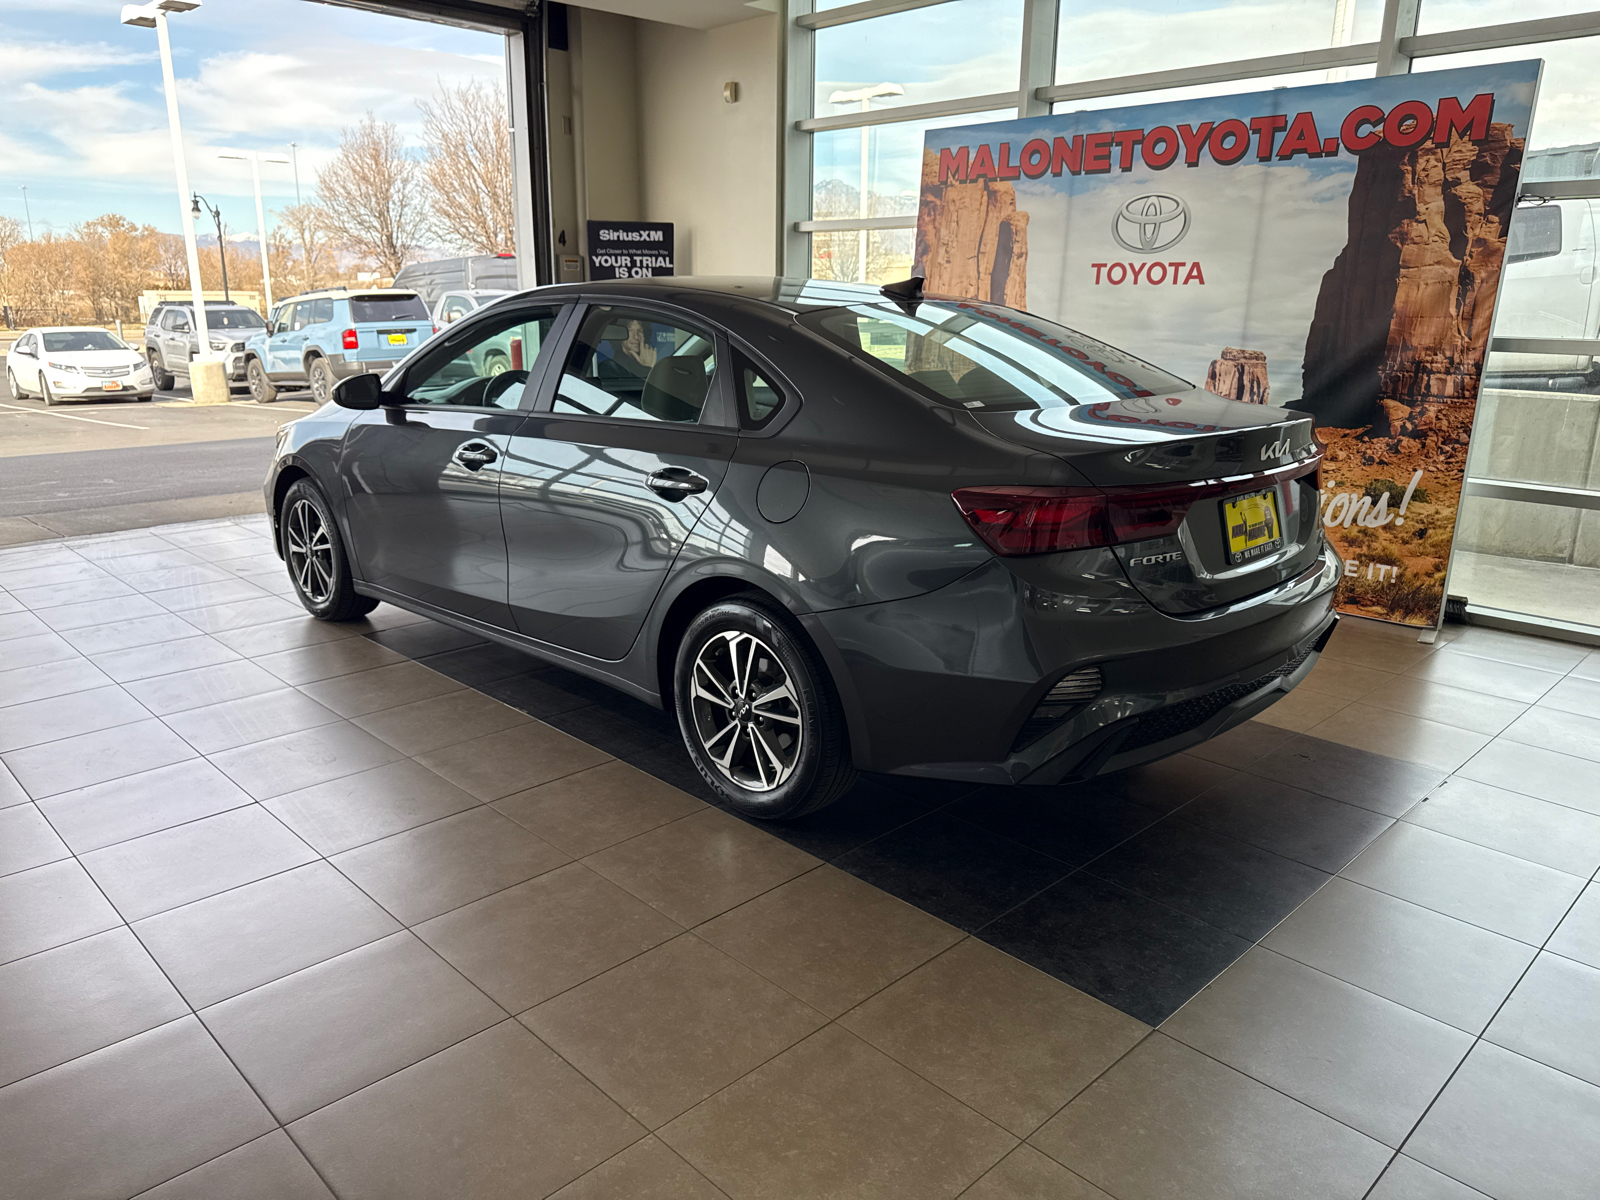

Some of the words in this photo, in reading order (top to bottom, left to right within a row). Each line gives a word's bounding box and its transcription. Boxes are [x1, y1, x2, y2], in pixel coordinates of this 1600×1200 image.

[939, 93, 1495, 183] MALONETOYOTA.COM
[558, 230, 567, 247] 4
[599, 229, 663, 242] SiriusXM
[592, 255, 631, 267] YOUR
[633, 256, 673, 268] TRIAL
[615, 267, 629, 278] IS
[631, 267, 652, 278] ON
[1091, 261, 1206, 286] TOYOTA
[1320, 469, 1424, 529] ions!
[1129, 551, 1182, 567] FORTE
[1344, 559, 1359, 577] E
[1367, 563, 1398, 584] IT!
